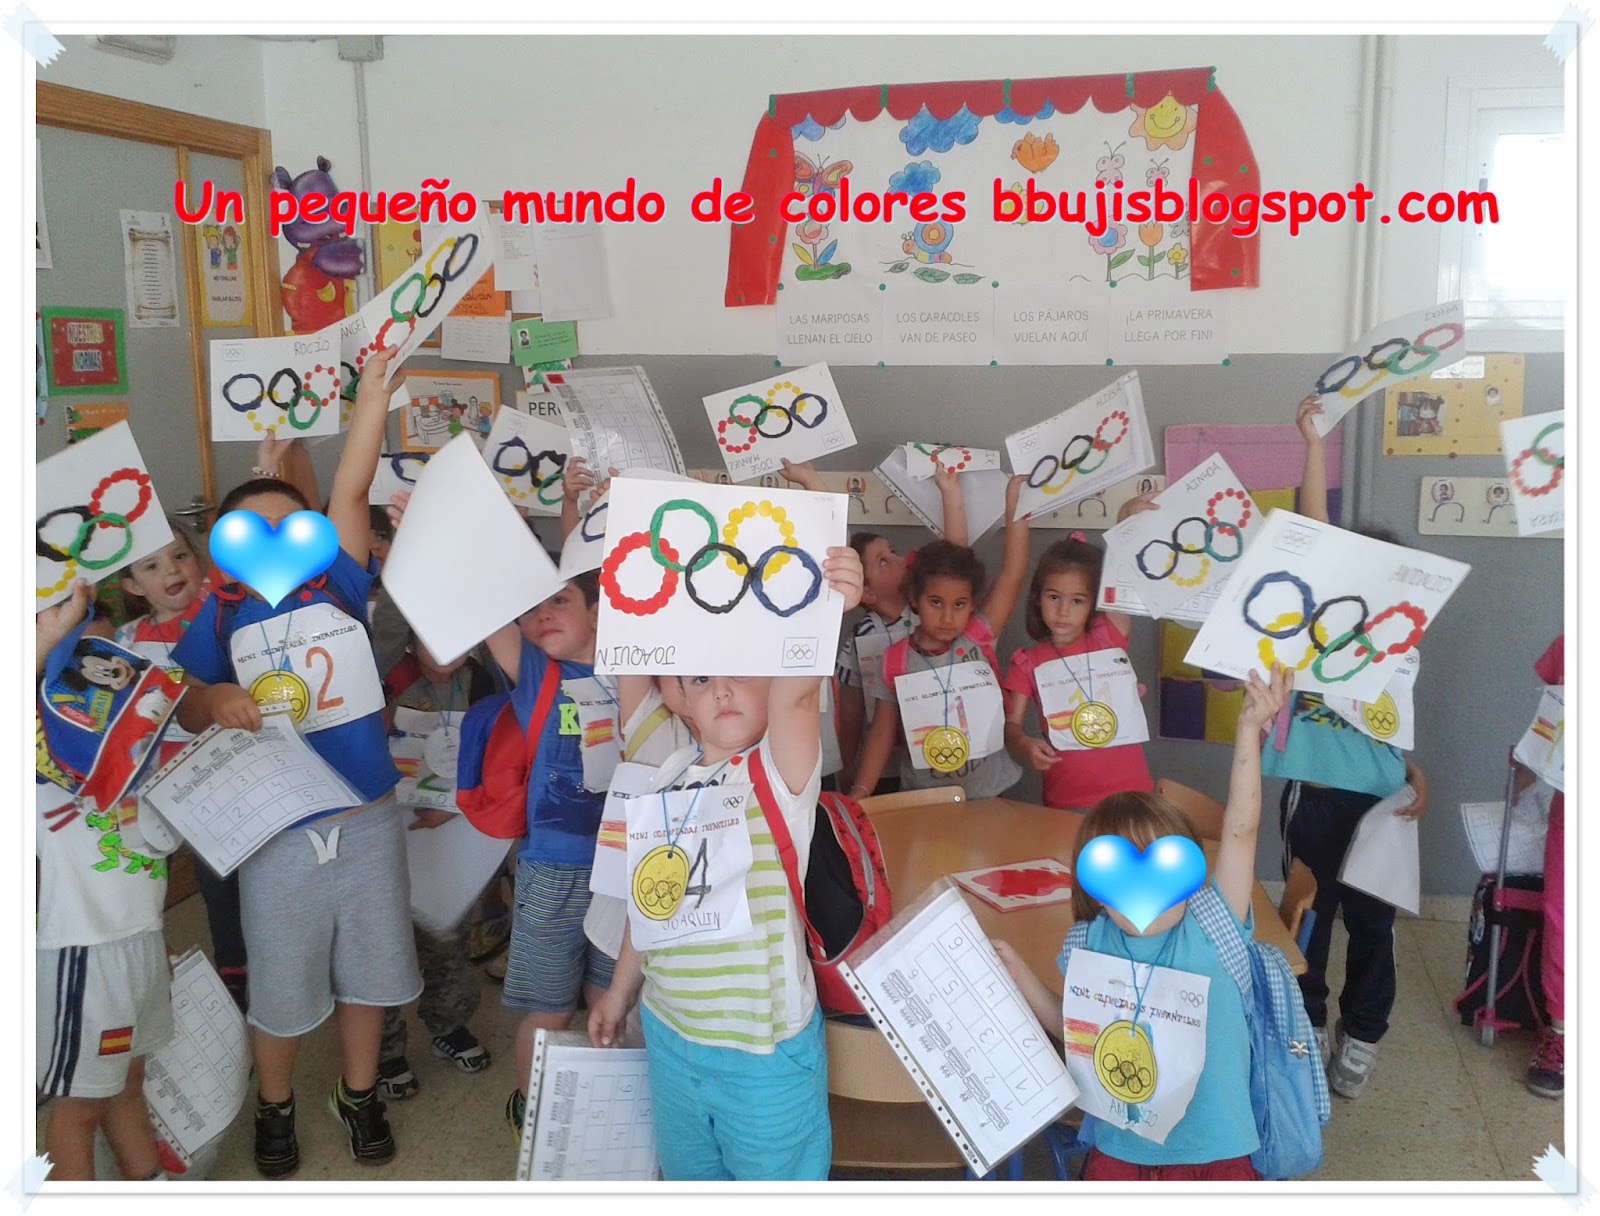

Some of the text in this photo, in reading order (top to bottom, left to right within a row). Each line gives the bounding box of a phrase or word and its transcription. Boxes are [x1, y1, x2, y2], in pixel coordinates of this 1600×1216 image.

[789, 313, 870, 325] LAS MARIPOSAS
[897, 312, 980, 323] LOS CARACOLES
[1013, 308, 1089, 322] LOS PÁJAROS
[1147, 309, 1213, 320] PRIMAVERA
[788, 333, 873, 345] LLENAN EL CIELO
[900, 331, 977, 343] VAN DE PASEO
[1013, 328, 1089, 343] VUELAN AQUÍ
[1124, 329, 1213, 342] LLEGA POR FIN!
[237, 652, 257, 664] MINI
[305, 646, 344, 711] 2
[236, 775, 248, 787] 3
[232, 806, 244, 818] 2
[629, 831, 649, 841] MINI
[979, 1027, 995, 1044] 3
[1022, 1033, 1038, 1048] 2
